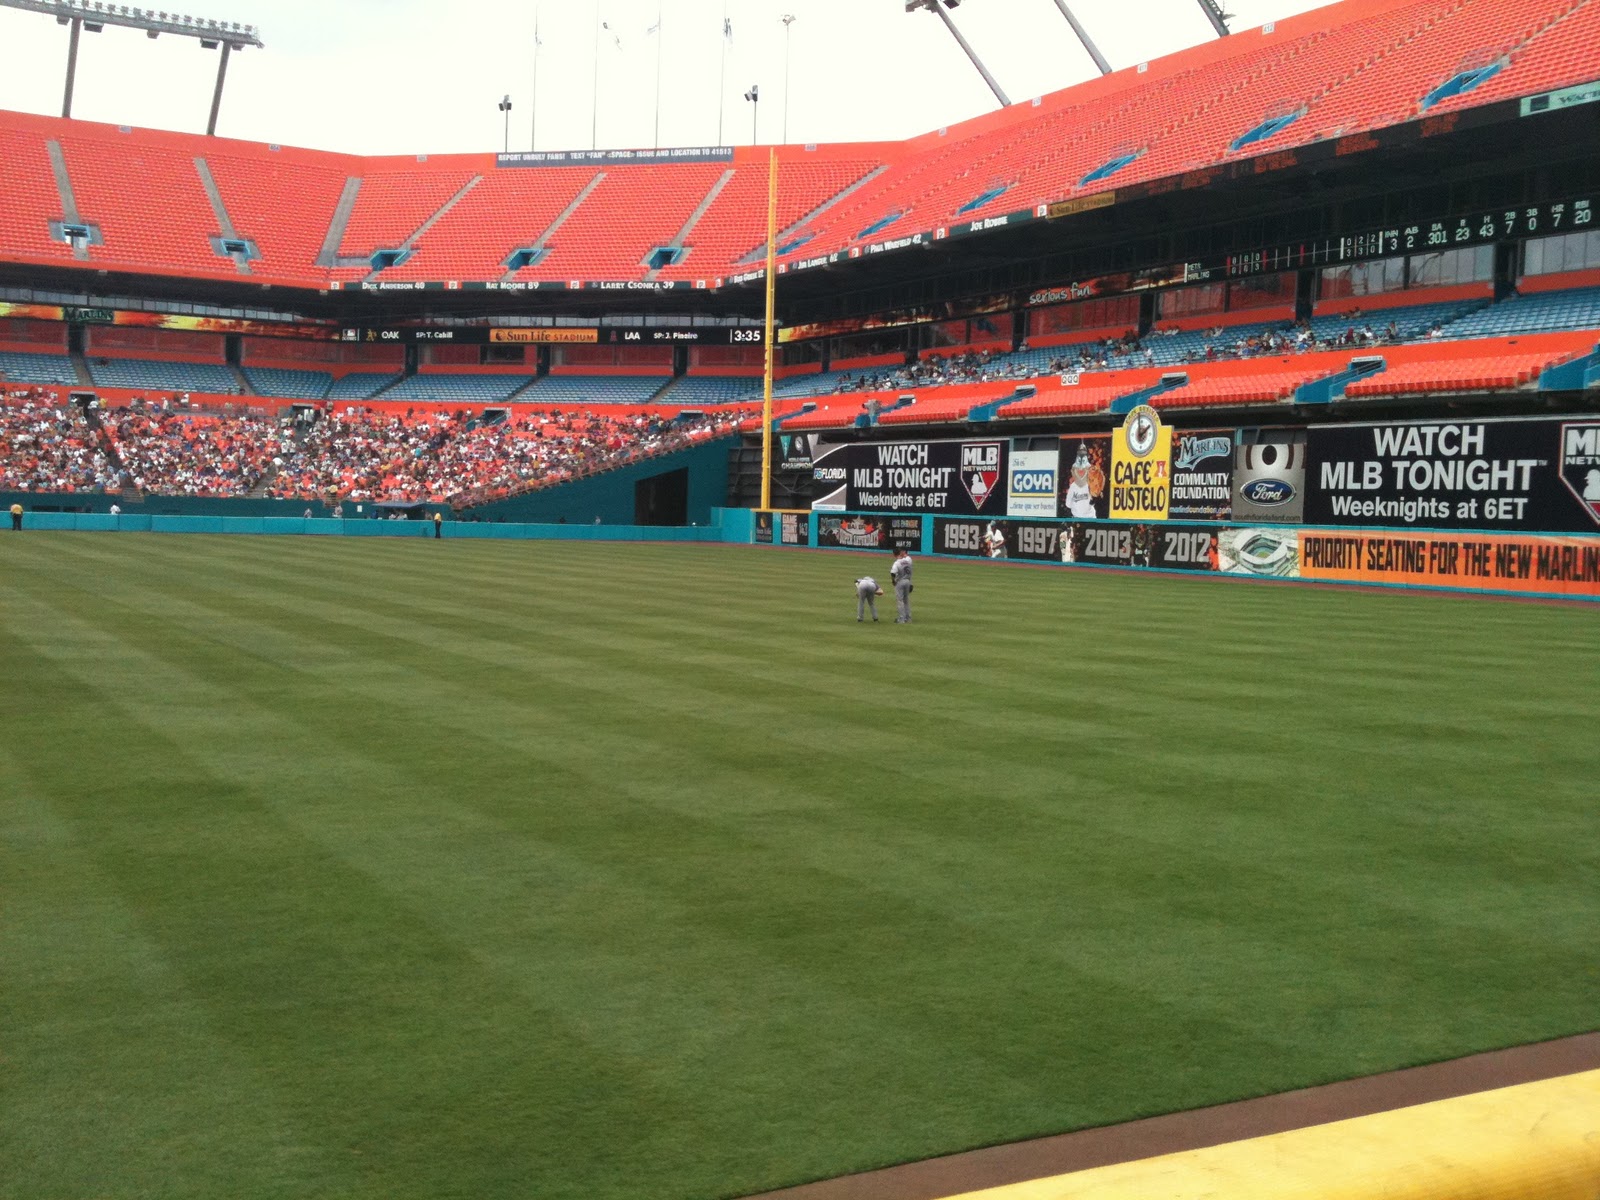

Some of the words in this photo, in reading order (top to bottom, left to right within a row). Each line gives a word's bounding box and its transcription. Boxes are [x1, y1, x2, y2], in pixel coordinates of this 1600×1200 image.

[1528, 218, 1536, 230] 0
[1552, 214, 1562, 227] 7
[1574, 209, 1592, 224] 20
[1456, 228, 1470, 241] 23
[1480, 224, 1494, 238] 43
[1506, 220, 1513, 234] 7
[1391, 238, 1398, 250] 3
[1407, 236, 1414, 248] 2
[528, 282, 540, 290] 89
[1030, 289, 1068, 304] serious
[1072, 282, 1091, 299] fun
[382, 331, 400, 339] OAK
[507, 332, 528, 341] Sun
[530, 330, 550, 341] Life
[624, 332, 640, 340] LAA
[734, 330, 760, 342] 3:35
[1374, 425, 1485, 457] WATCH
[878, 444, 928, 466] WATCH
[963, 446, 998, 466] MLB
[1176, 436, 1230, 466] MARLINS
[822, 468, 846, 480] FLORIDA
[854, 468, 883, 488] MLB
[886, 468, 951, 488] TONIGHT
[1014, 473, 1053, 492] GOYA
[1174, 472, 1230, 486] COMMUNITY
[1320, 461, 1383, 490] MLB
[1392, 459, 1538, 491] TONIGHT
[1112, 486, 1166, 512] BUSTELO
[1172, 487, 1230, 500] FOUNDATION
[1252, 482, 1284, 500] Ford
[858, 492, 913, 510] Weeknights
[916, 494, 926, 508] at
[928, 492, 948, 508] 6ET
[1332, 496, 1450, 522] Weeknights
[1456, 498, 1478, 519] at
[1484, 498, 1528, 520] 6ET
[944, 524, 980, 550] 1993
[1018, 526, 1058, 554] 1997
[1085, 528, 1132, 558] 2003
[1164, 532, 1210, 562] 2012
[1304, 537, 1364, 570] PRIORITY
[1367, 539, 1426, 573] SEATING
[1429, 541, 1458, 576] FOR
[1463, 542, 1490, 578] THE
[1496, 544, 1532, 580] NEW
